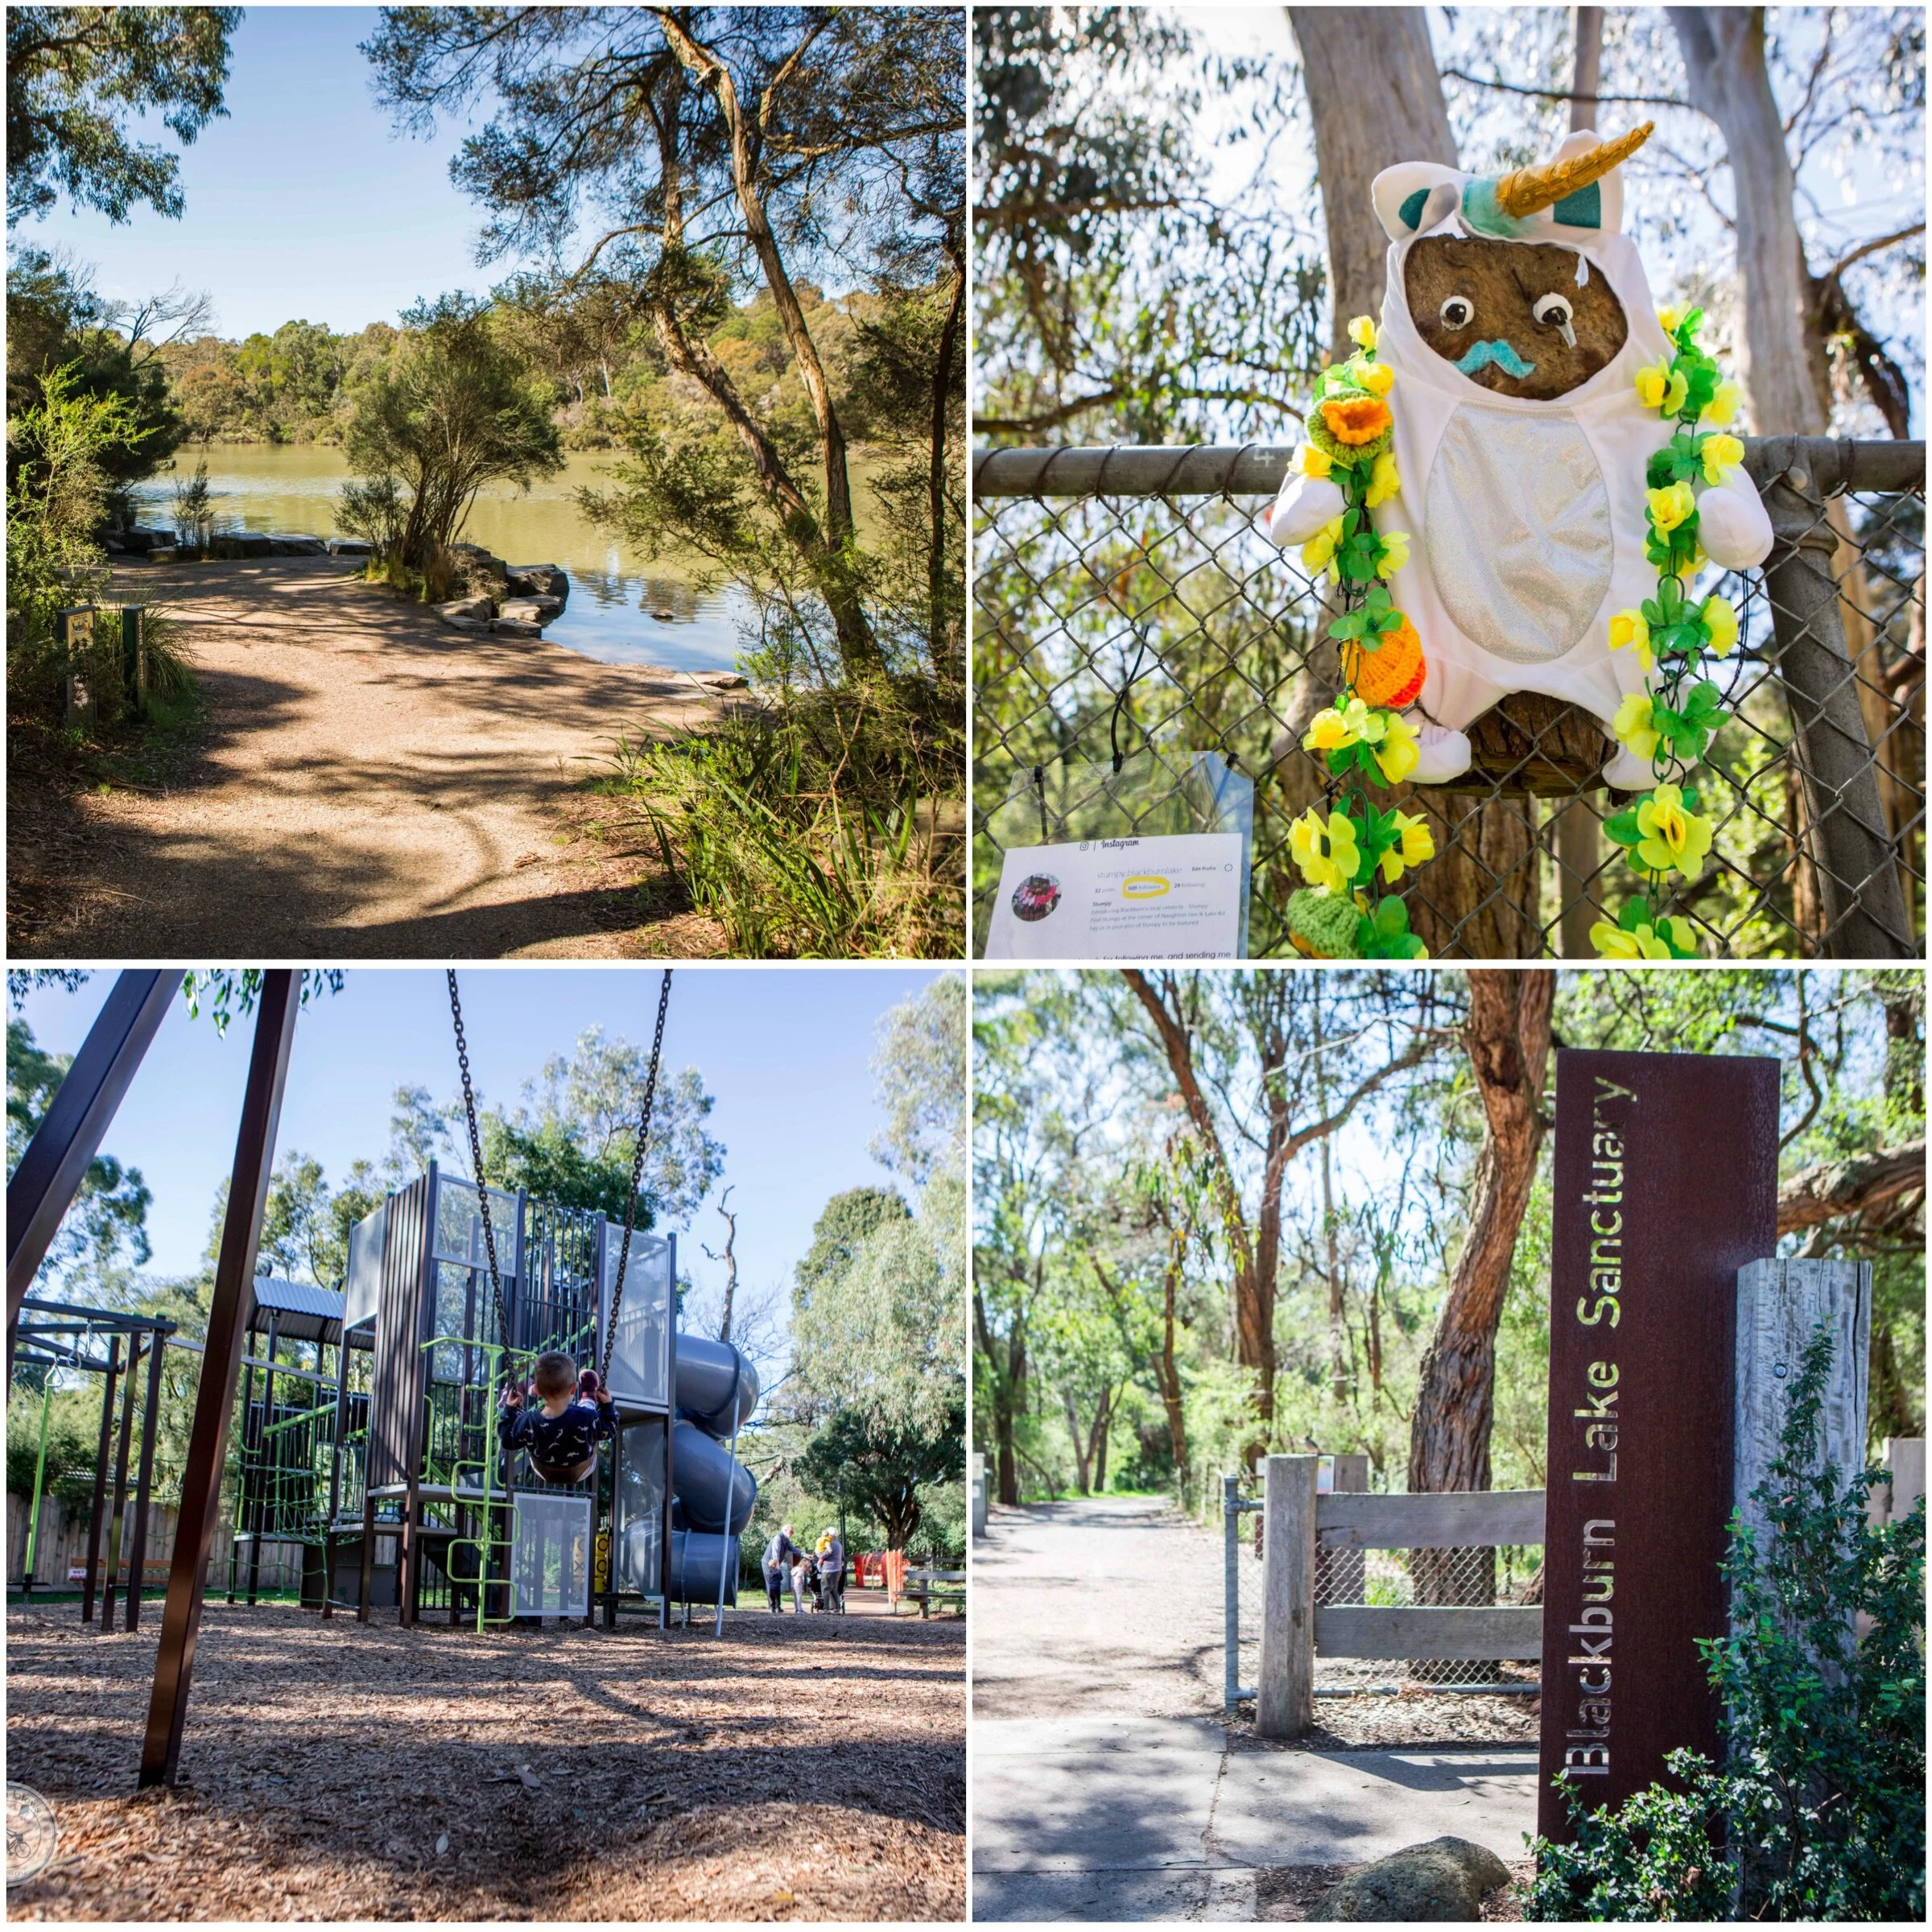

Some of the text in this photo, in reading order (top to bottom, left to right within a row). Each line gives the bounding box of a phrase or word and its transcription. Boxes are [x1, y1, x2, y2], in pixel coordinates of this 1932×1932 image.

[1100, 839, 1140, 850] Instagram
[1185, 952, 1216, 960] sending
[1565, 1075, 1637, 1775] Blackburn Lake Sanctuary
